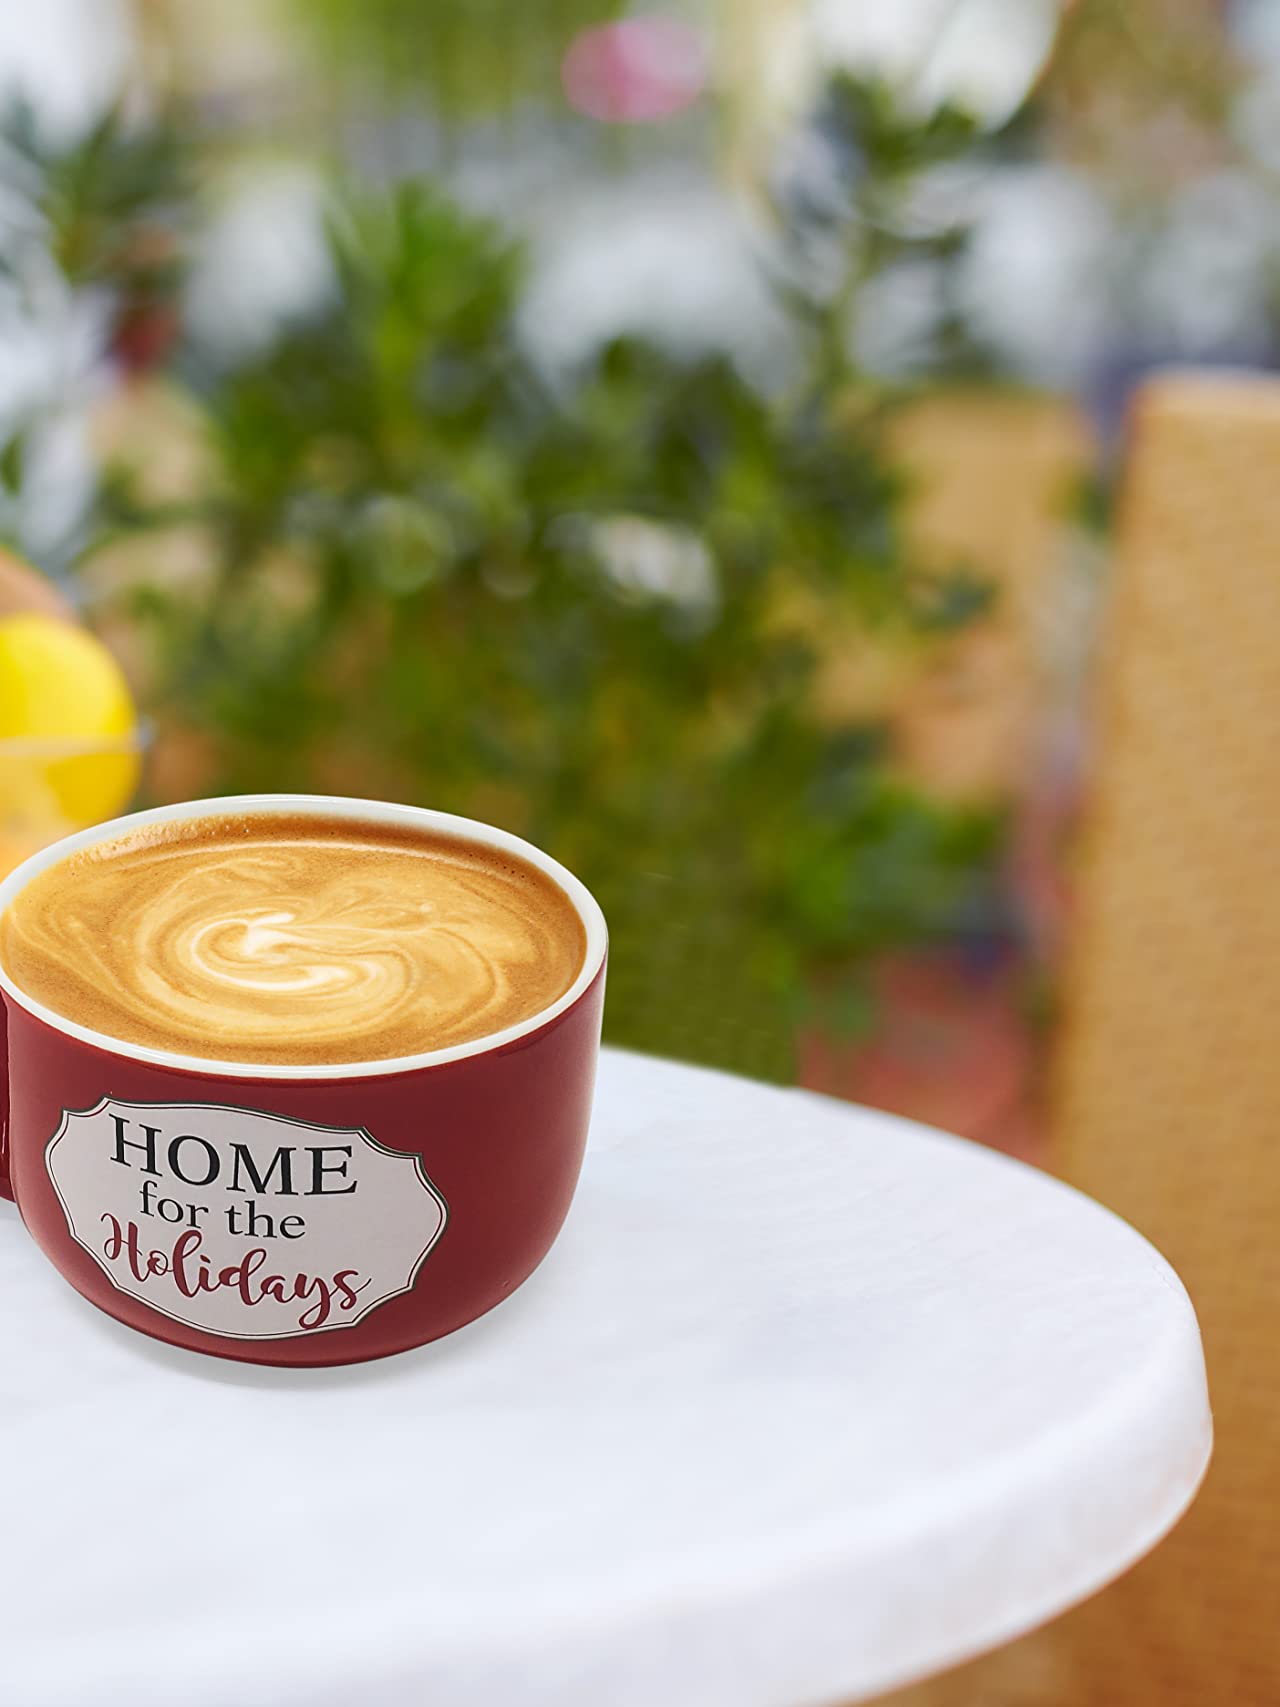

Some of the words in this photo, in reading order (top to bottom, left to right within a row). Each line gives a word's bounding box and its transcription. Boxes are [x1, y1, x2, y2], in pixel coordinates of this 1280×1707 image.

[108, 1113, 358, 1196] HOME
[139, 1180, 209, 1229] for
[223, 1199, 306, 1240] the
[100, 1213, 371, 1330] Holidays
